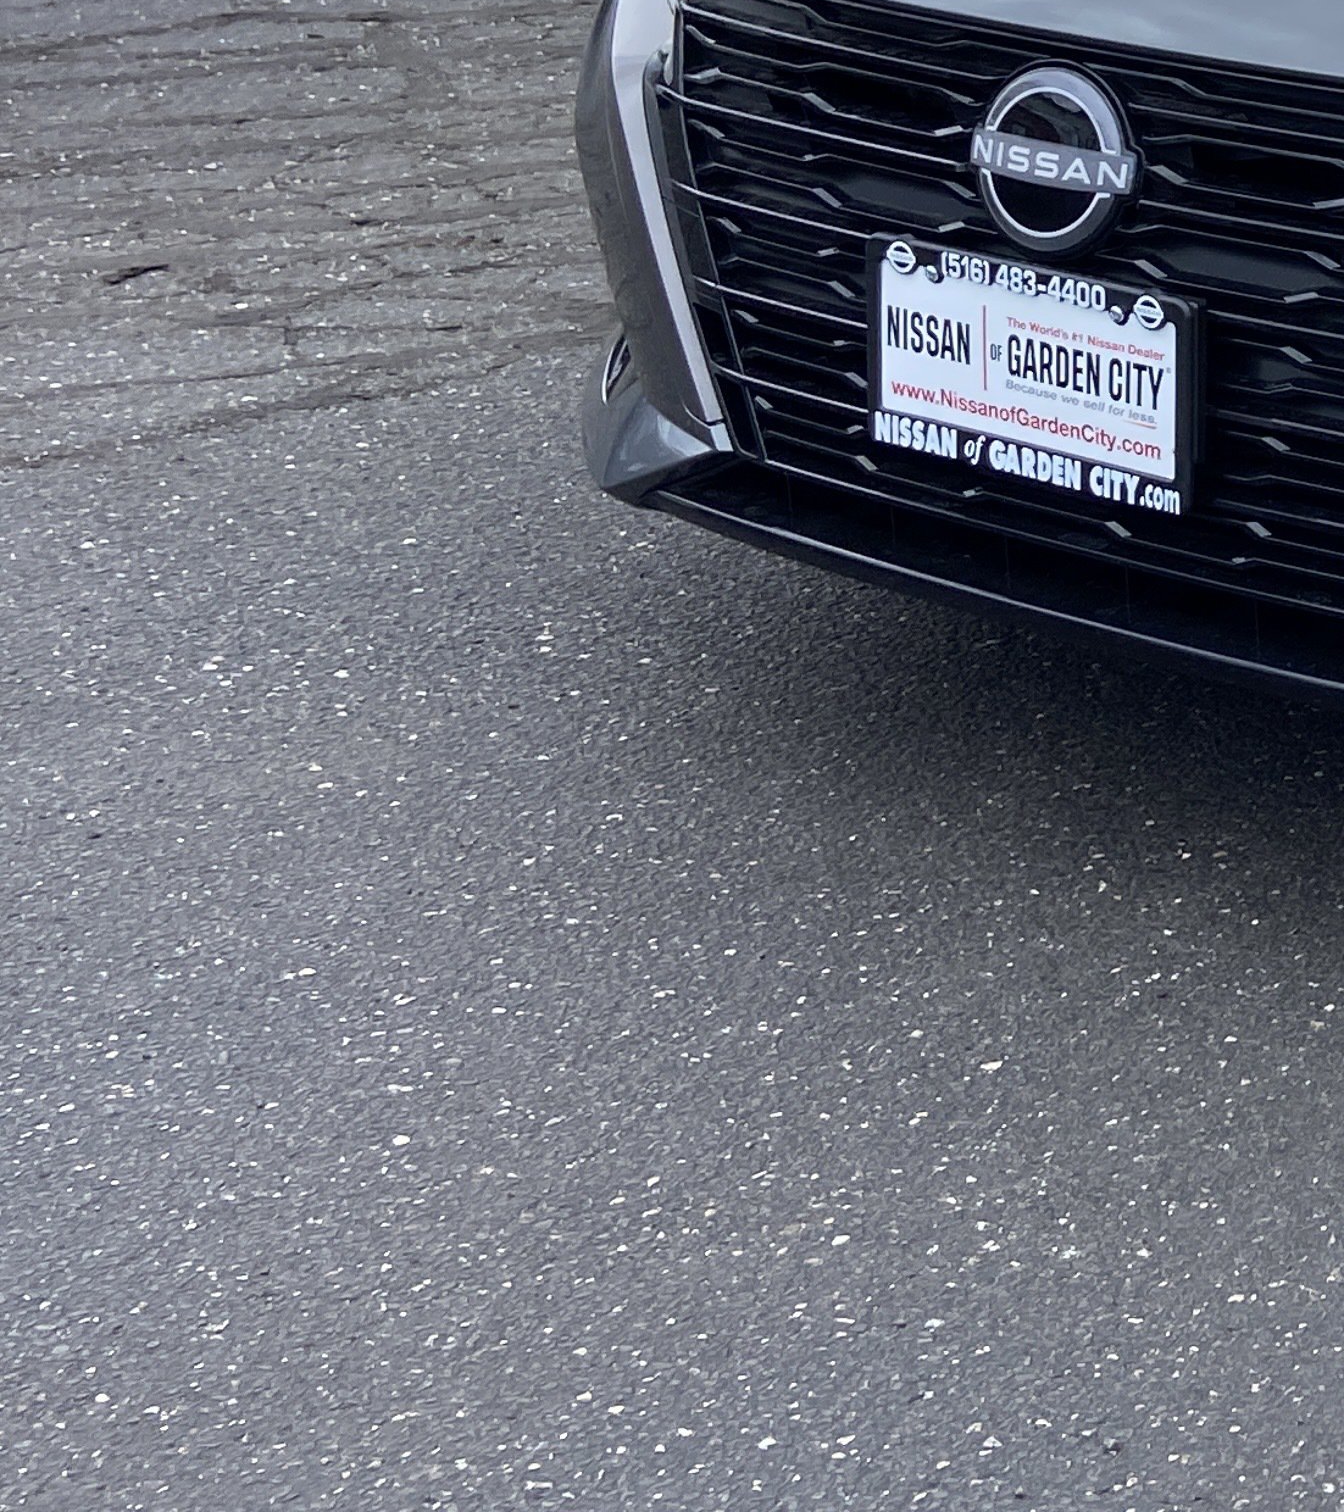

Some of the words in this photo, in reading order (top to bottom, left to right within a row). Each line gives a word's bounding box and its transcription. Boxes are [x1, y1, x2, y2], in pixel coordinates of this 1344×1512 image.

[973, 134, 1128, 188] NISSAN
[941, 251, 990, 286] (516)
[995, 264, 1106, 311] 483-4400
[887, 304, 970, 365] NISSAN
[990, 343, 1003, 362] OF
[1007, 333, 1101, 397] GARDEN
[1109, 357, 1164, 411] CITY
[1006, 316, 1026, 331] The
[1087, 334, 1125, 353] Nissan
[1128, 343, 1165, 361] Dealer
[890, 380, 1162, 460] www.NissanofGardenCity.com
[1006, 378, 1058, 401] Because
[1061, 394, 1080, 406] we
[1083, 399, 1105, 413] sell
[1108, 404, 1125, 417] for
[874, 410, 957, 459] NISSAN
[964, 435, 986, 465] of
[989, 439, 1081, 491] GARDEN
[1089, 465, 1181, 515] CITY.com
